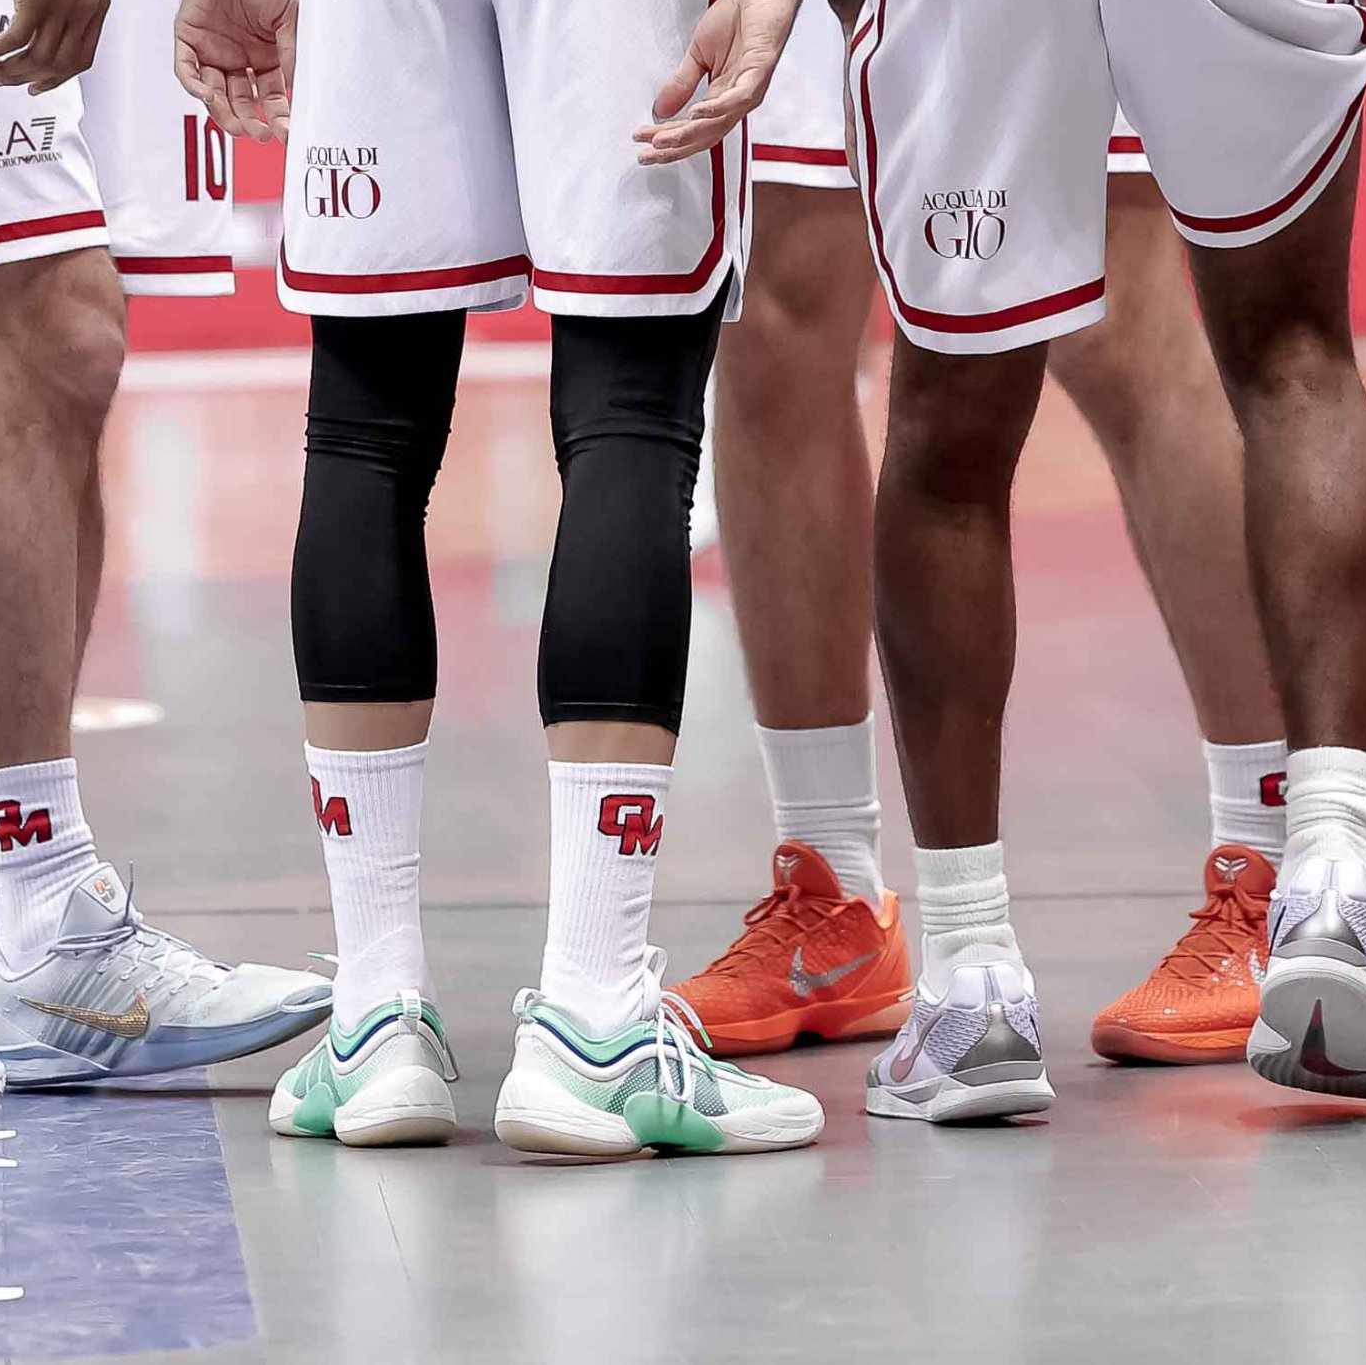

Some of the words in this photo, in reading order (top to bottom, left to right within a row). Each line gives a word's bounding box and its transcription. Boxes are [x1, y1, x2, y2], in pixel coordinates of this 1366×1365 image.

[33, 151, 63, 165] ARMAN
[183, 114, 227, 201] 10
[304, 145, 352, 166] ACQUA
[356, 147, 379, 166] DI
[304, 165, 381, 220] GIÒ
[921, 188, 984, 211] ACQUA
[987, 189, 1008, 209] DI
[924, 208, 1006, 261] GIÒ
